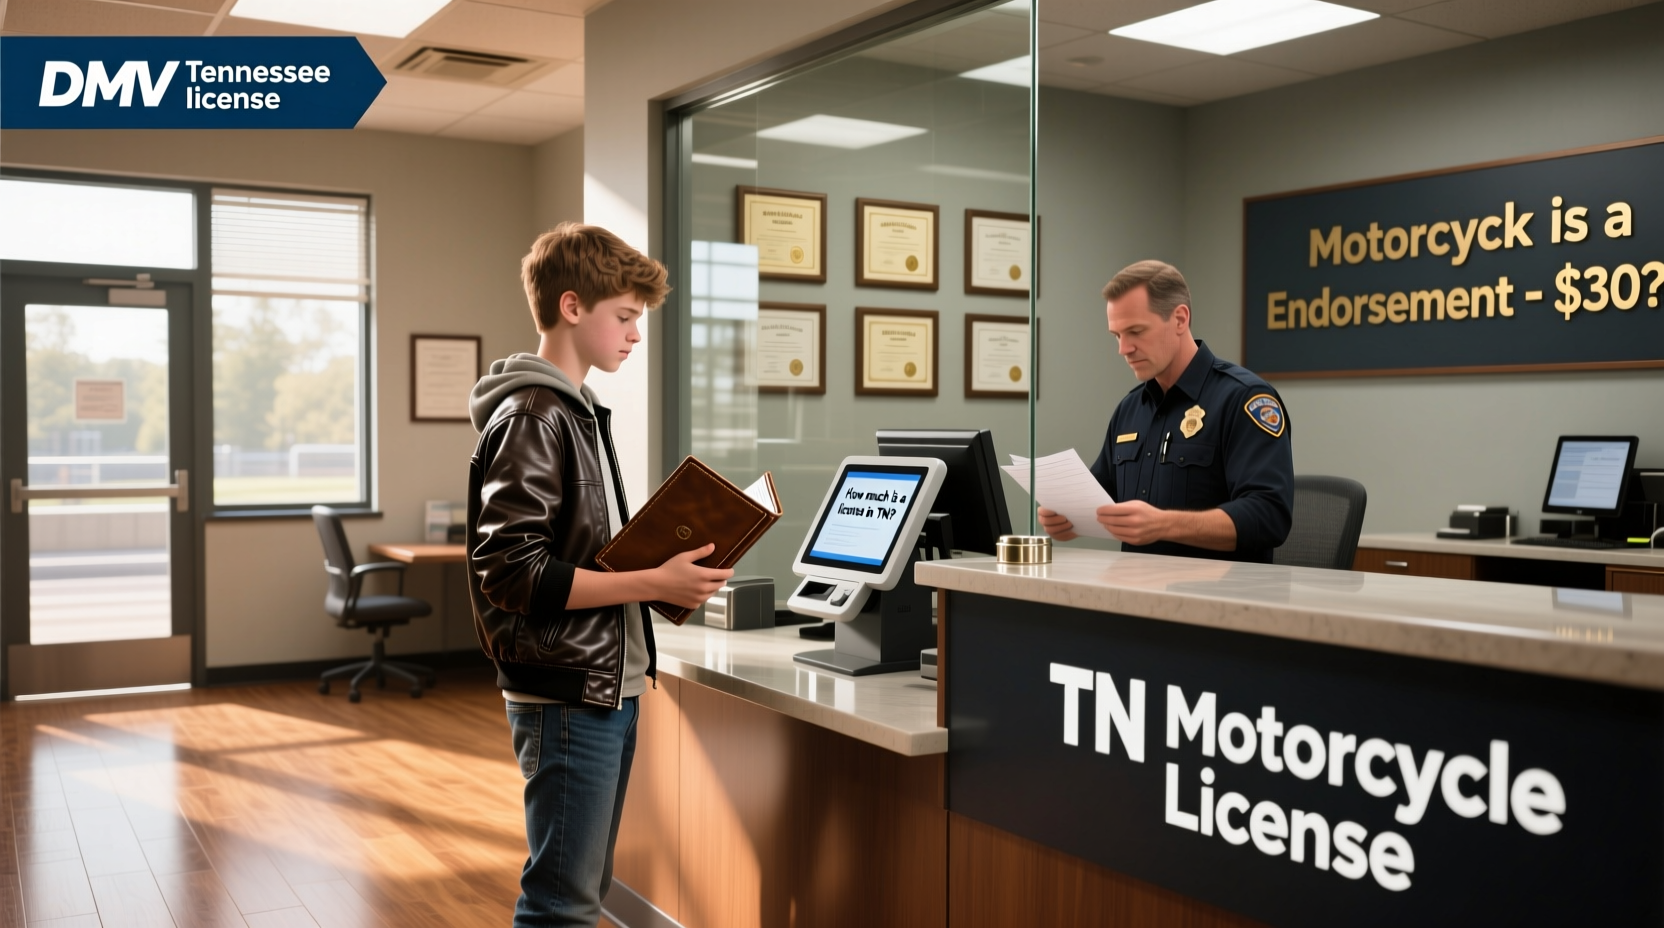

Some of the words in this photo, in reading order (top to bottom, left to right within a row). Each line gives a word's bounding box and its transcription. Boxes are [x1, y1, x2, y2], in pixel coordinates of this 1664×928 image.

[1309, 201, 1534, 267] Motorcyck
[1551, 195, 1589, 244] is
[1604, 202, 1633, 238] a
[1267, 276, 1514, 330] Endorsement
[1525, 290, 1543, 301] -
[1554, 261, 1664, 321] $30?
[1050, 662, 1146, 763] TN
[1166, 684, 1566, 835] Motorcycle
[1165, 762, 1415, 891] License
